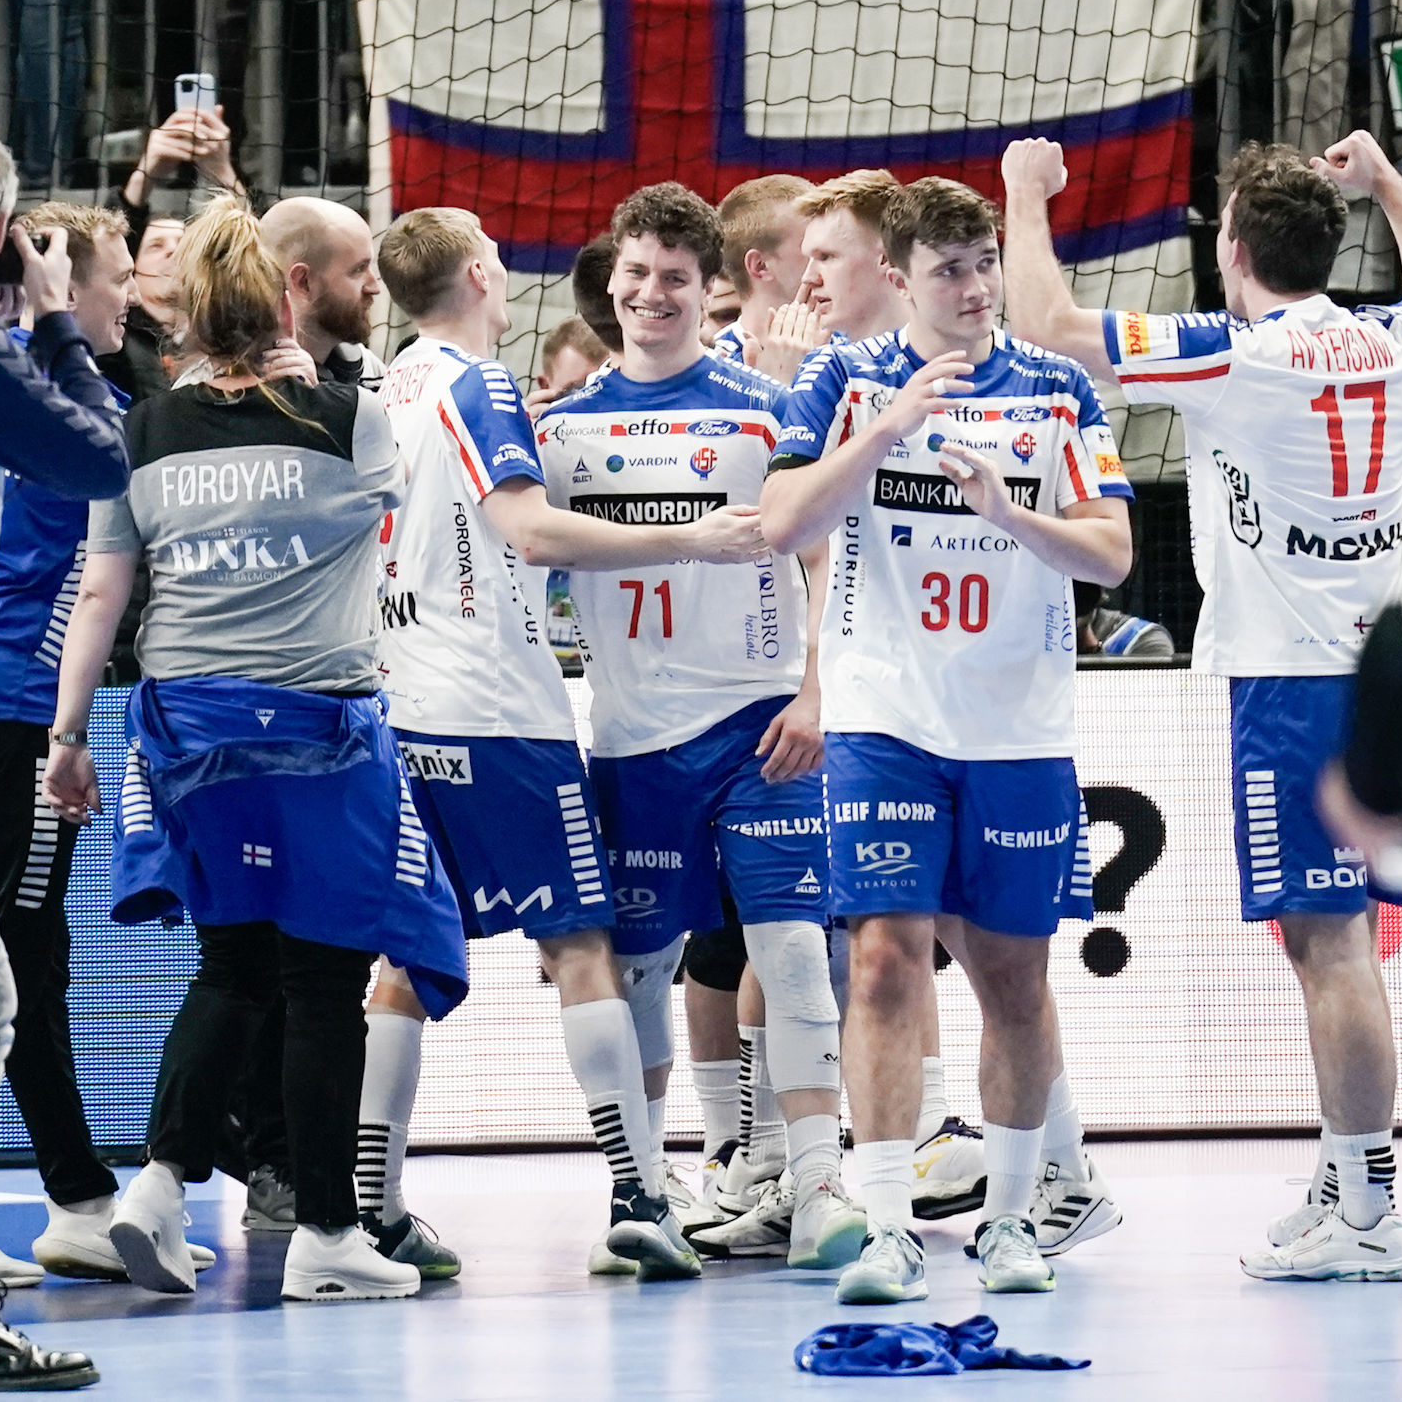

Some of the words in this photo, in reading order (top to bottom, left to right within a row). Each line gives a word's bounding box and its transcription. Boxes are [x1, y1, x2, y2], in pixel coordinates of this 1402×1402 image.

[708, 371, 743, 393] SMYRIL
[744, 386, 769, 401] LINE
[1044, 369, 1069, 384] LINE
[1010, 406, 1044, 422] Ford
[560, 426, 606, 437] NAVIGARE
[628, 418, 670, 436] effo
[695, 419, 731, 436] Ford
[1310, 380, 1386, 497] 17
[629, 456, 677, 467] VARDIN
[161, 459, 305, 508] FØROYAR
[842, 516, 860, 637] DJURHUUS
[619, 580, 673, 639] 71
[921, 572, 990, 633] 30
[835, 801, 870, 823] LEIF
[877, 801, 937, 821] MOHR
[625, 850, 684, 870] MOHR
[855, 841, 913, 863] KD
[855, 878, 918, 890] SEAFOOD
